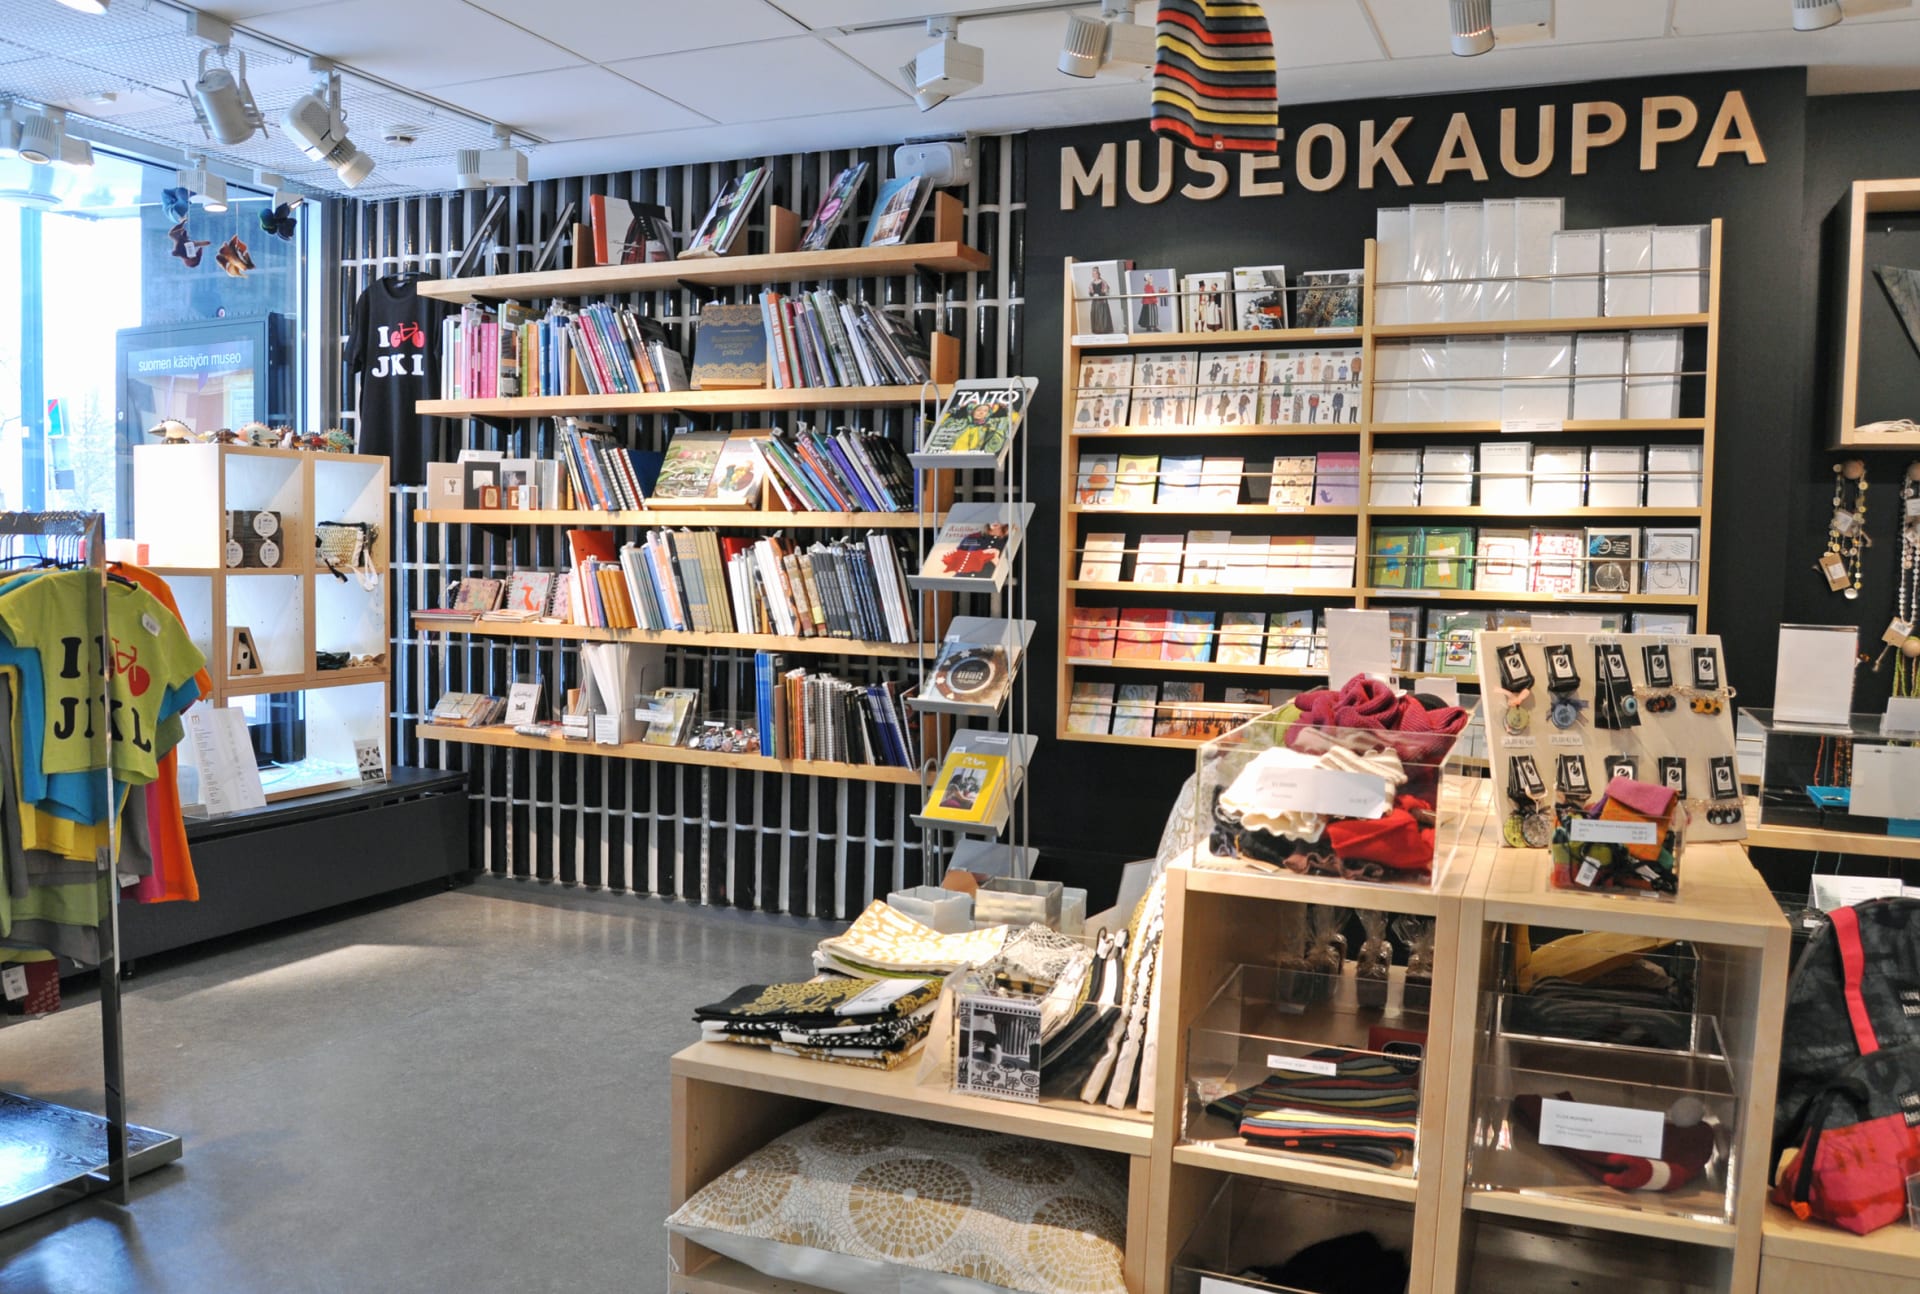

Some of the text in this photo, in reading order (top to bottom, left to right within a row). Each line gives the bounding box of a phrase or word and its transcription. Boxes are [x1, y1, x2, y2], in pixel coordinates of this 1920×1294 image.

[1060, 90, 1767, 210] MUSEOKAUPPA
[377, 325, 391, 348] I
[138, 352, 241, 372] suomen käsityön museo
[957, 390, 1020, 405] TAITO
